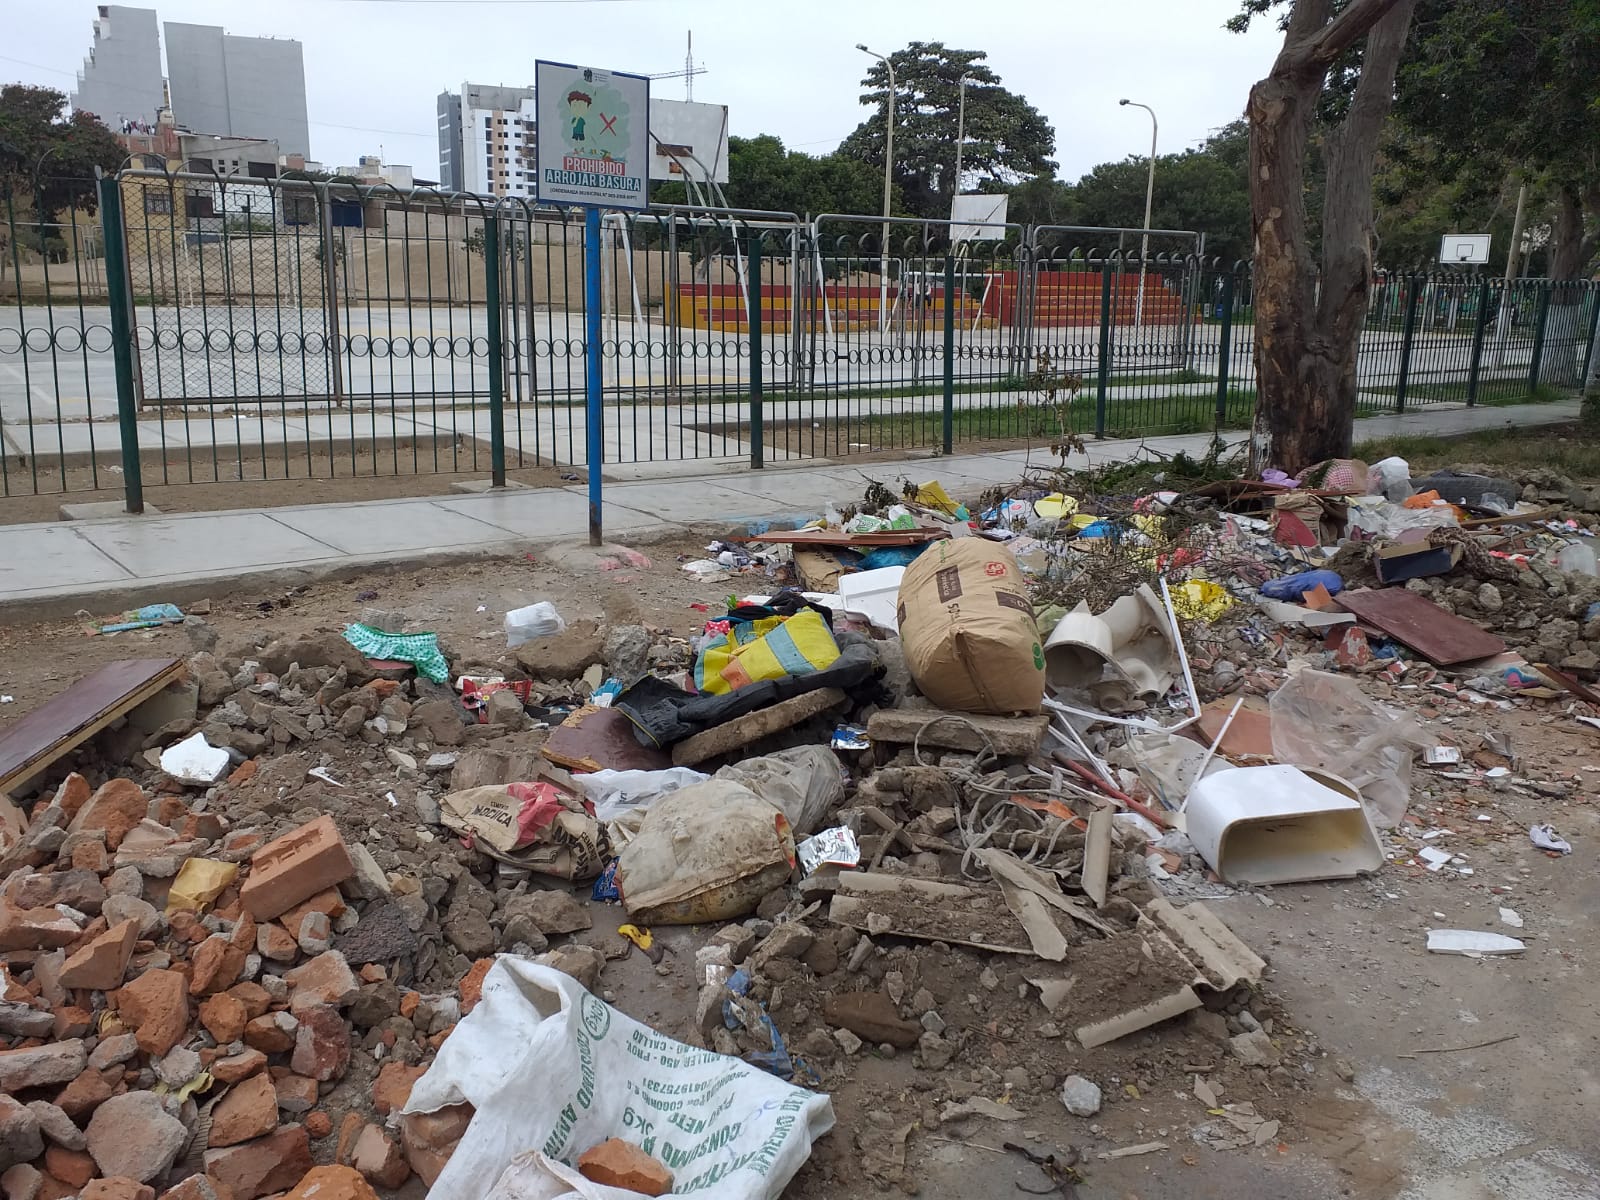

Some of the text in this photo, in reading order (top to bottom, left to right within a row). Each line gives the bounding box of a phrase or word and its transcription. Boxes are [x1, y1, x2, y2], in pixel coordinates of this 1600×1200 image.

[566, 157, 623, 175] PROHIBIDO
[546, 169, 641, 192] ARROJAR BASURA
[633, 1029, 667, 1052] CALLAO
[661, 1122, 742, 1169] CONSUMO
